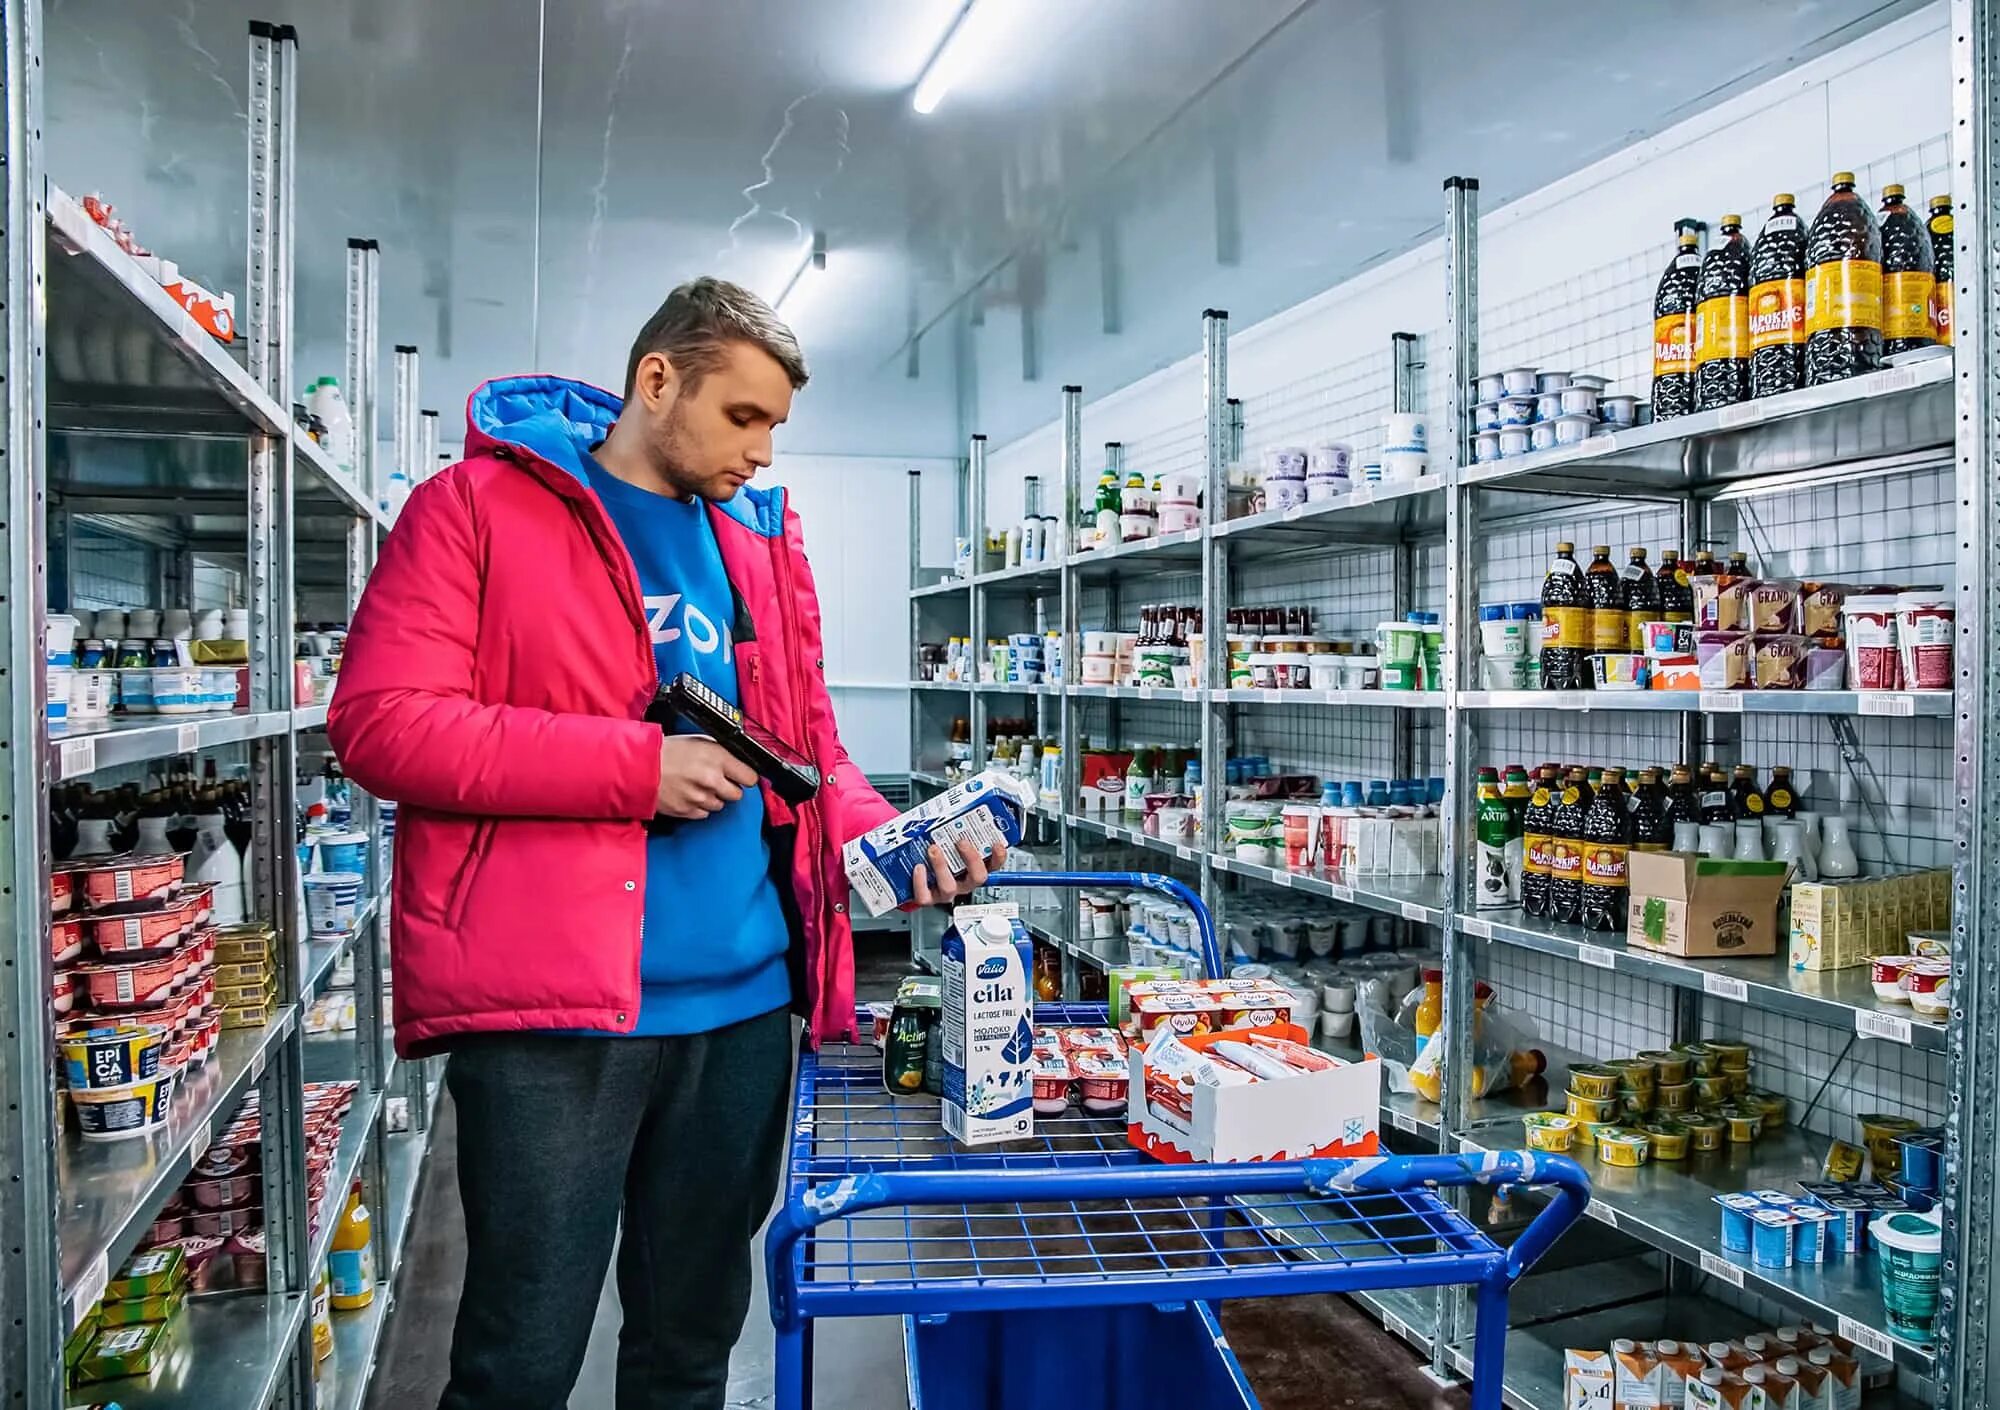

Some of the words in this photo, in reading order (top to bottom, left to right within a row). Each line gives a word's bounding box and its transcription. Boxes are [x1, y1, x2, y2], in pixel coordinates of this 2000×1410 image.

[1758, 590, 1790, 604] GRAND
[978, 963, 1004, 976] Valio
[973, 983, 1013, 1004] eila
[974, 1010, 1000, 1020] LACTOSE
[95, 1048, 121, 1065] EPI
[95, 1062, 123, 1077] CA
